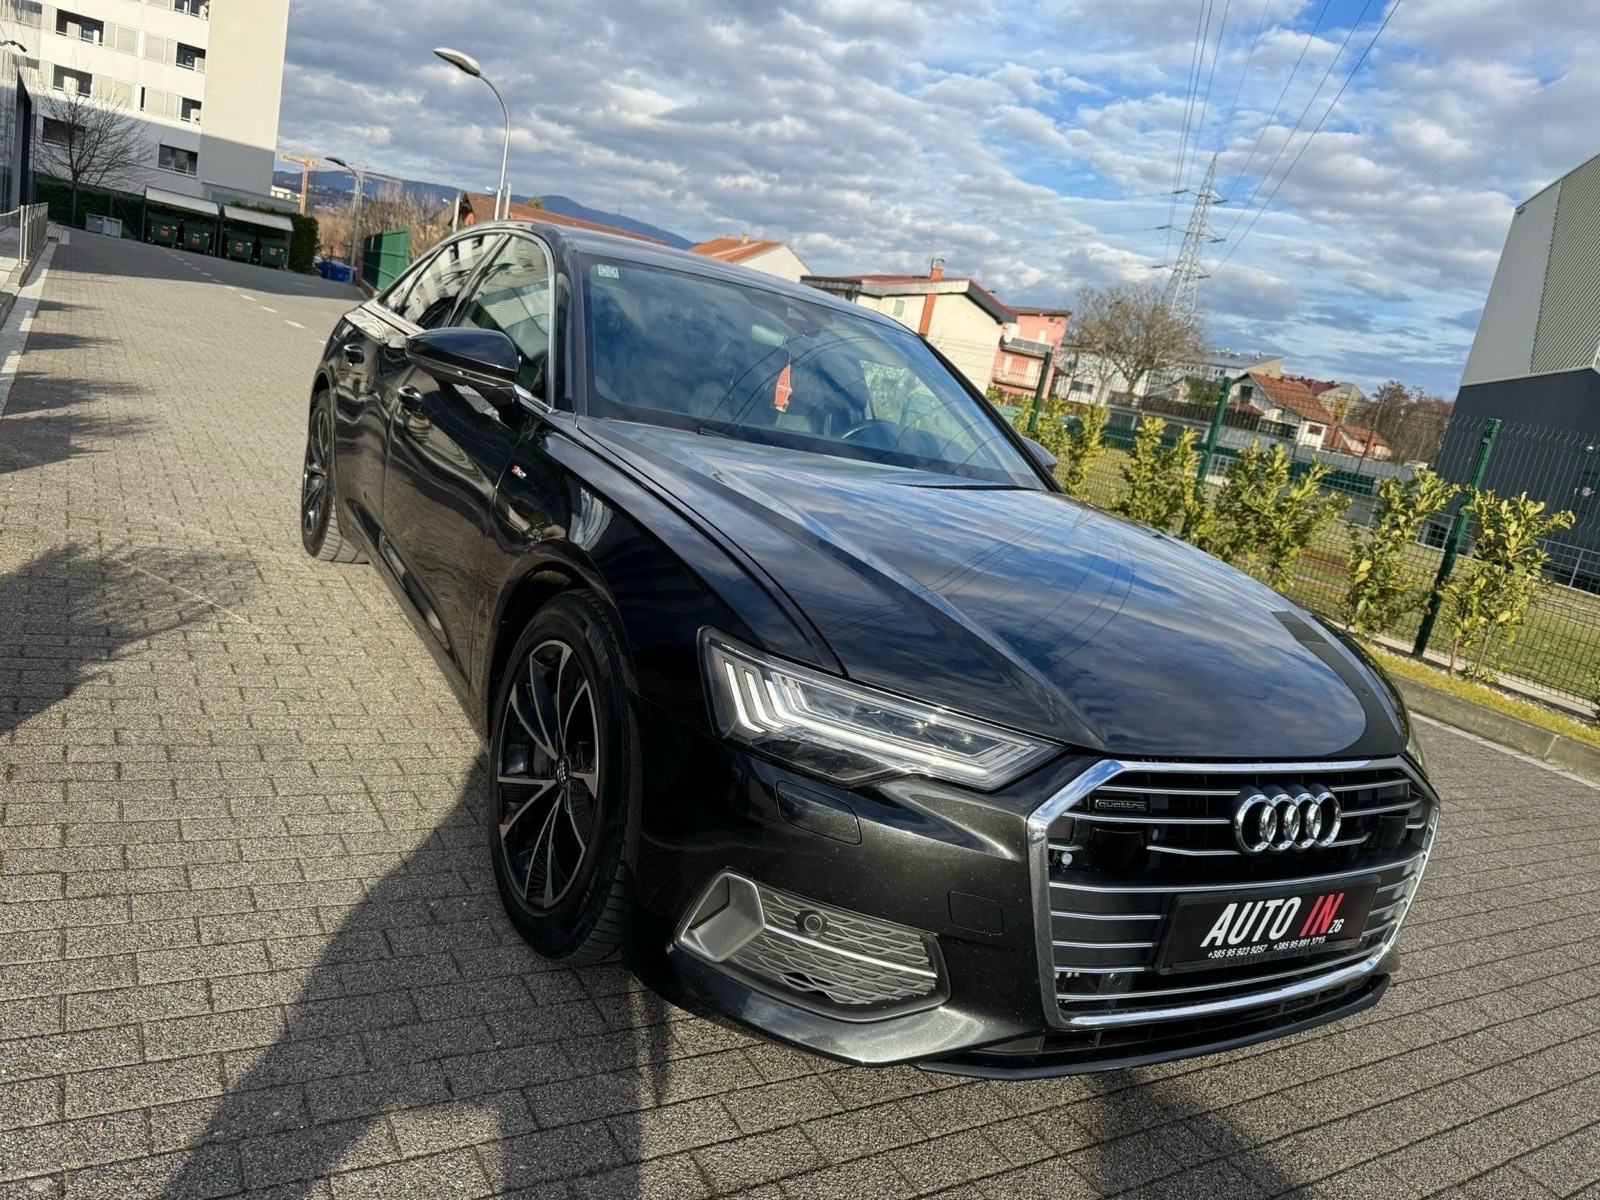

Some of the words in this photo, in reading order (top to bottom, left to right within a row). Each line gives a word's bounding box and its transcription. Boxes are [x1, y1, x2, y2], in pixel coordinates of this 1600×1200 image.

[1098, 801, 1145, 809] quattro
[1200, 896, 1302, 948] AUTO
[1299, 893, 1344, 937] IN
[1328, 919, 1344, 934] ZG
[1208, 949, 1227, 959] +385
[1226, 948, 1237, 957] 95
[1236, 946, 1250, 956] 923
[1250, 944, 1268, 954] 9257
[1273, 941, 1290, 950] +385
[1289, 940, 1299, 949] 95
